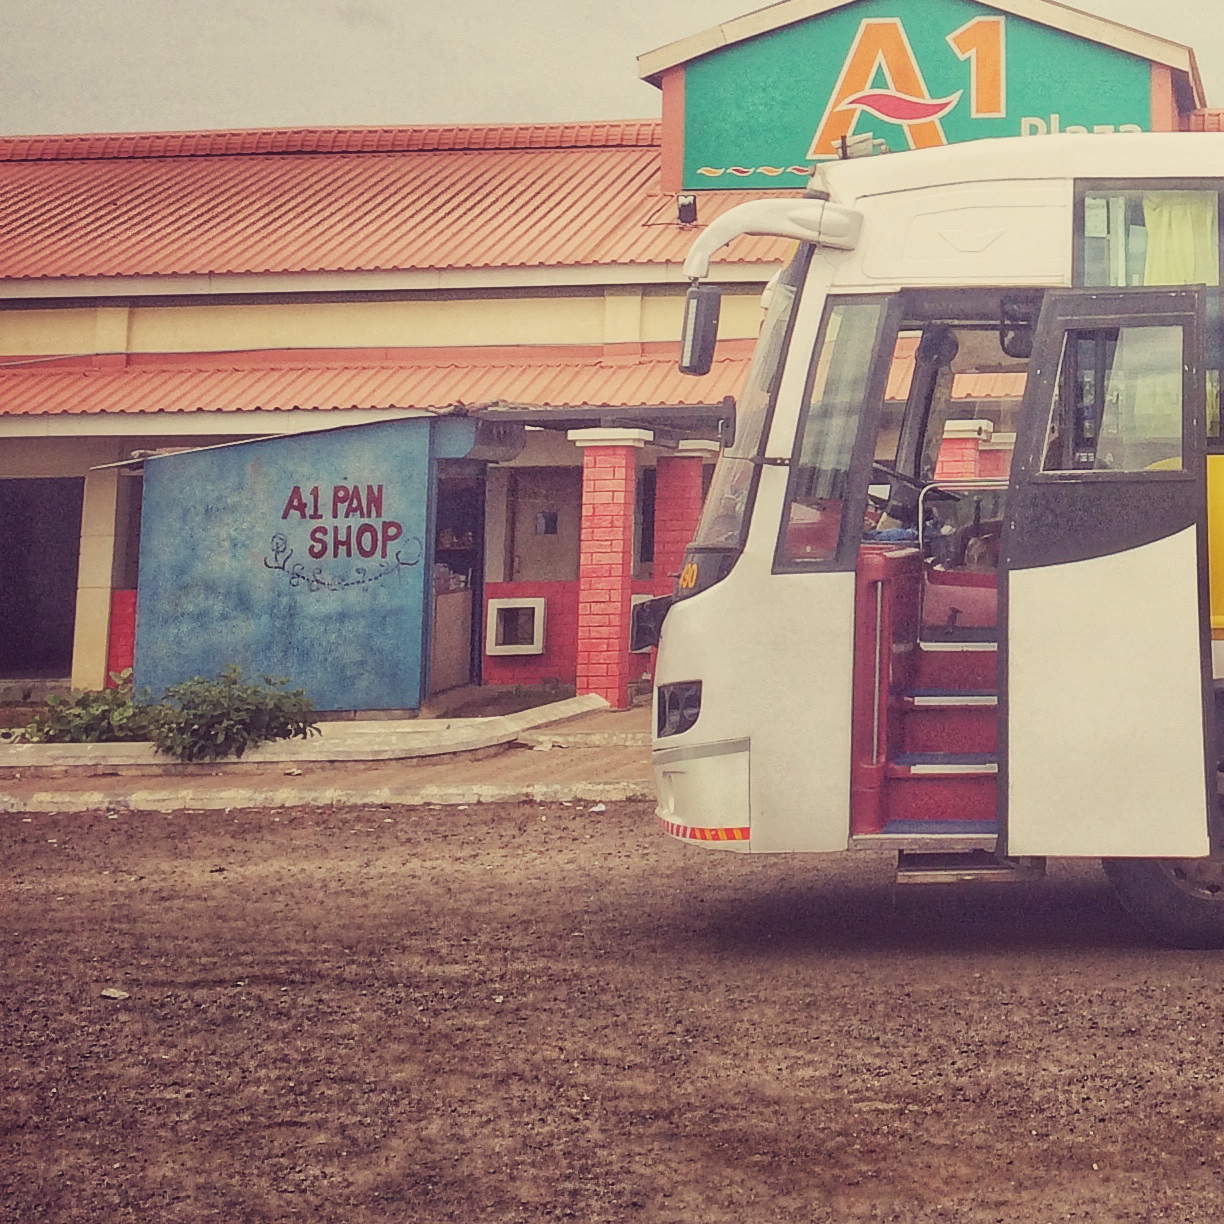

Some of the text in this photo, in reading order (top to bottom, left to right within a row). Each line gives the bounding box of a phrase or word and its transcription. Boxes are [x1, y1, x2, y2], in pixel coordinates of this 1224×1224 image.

[805, 16, 1006, 160] A1
[281, 484, 383, 519] A1 PAN
[308, 521, 403, 559] SHOP
